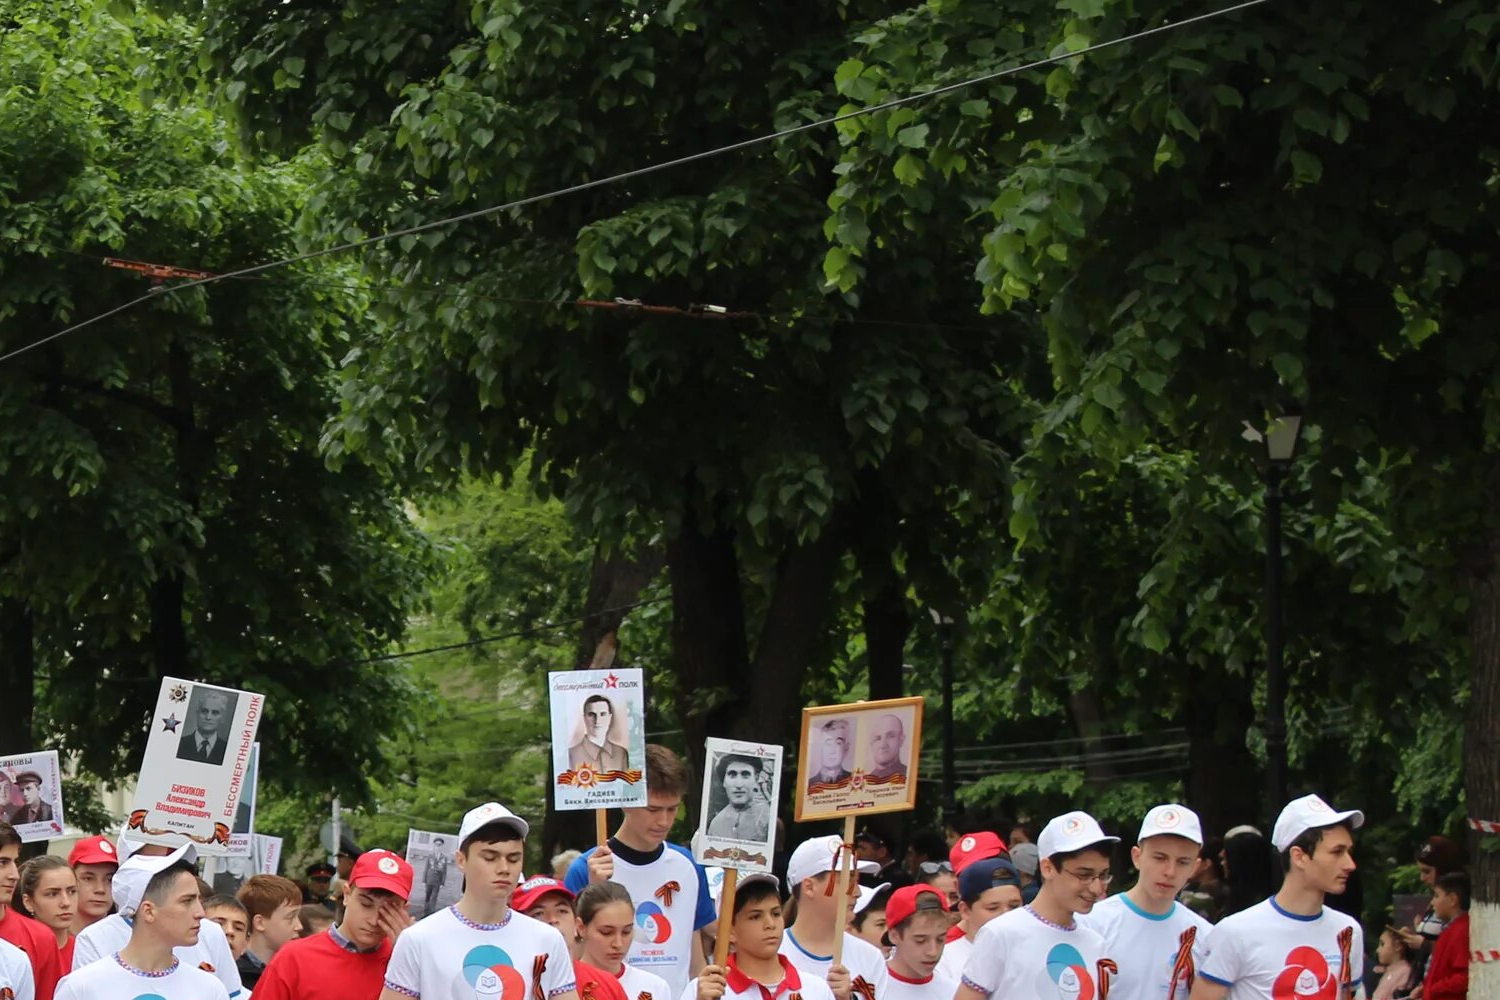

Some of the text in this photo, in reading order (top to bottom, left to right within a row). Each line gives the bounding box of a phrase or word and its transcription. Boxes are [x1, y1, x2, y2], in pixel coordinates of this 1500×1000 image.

[223, 695, 261, 817] БЕССМЕРТНЫЙ ПОЛК
[171, 784, 206, 797] БИЗИКОВ
[166, 794, 206, 808] Александр
[155, 802, 212, 819] Владимирович
[167, 820, 195, 829] КАПИТАН
